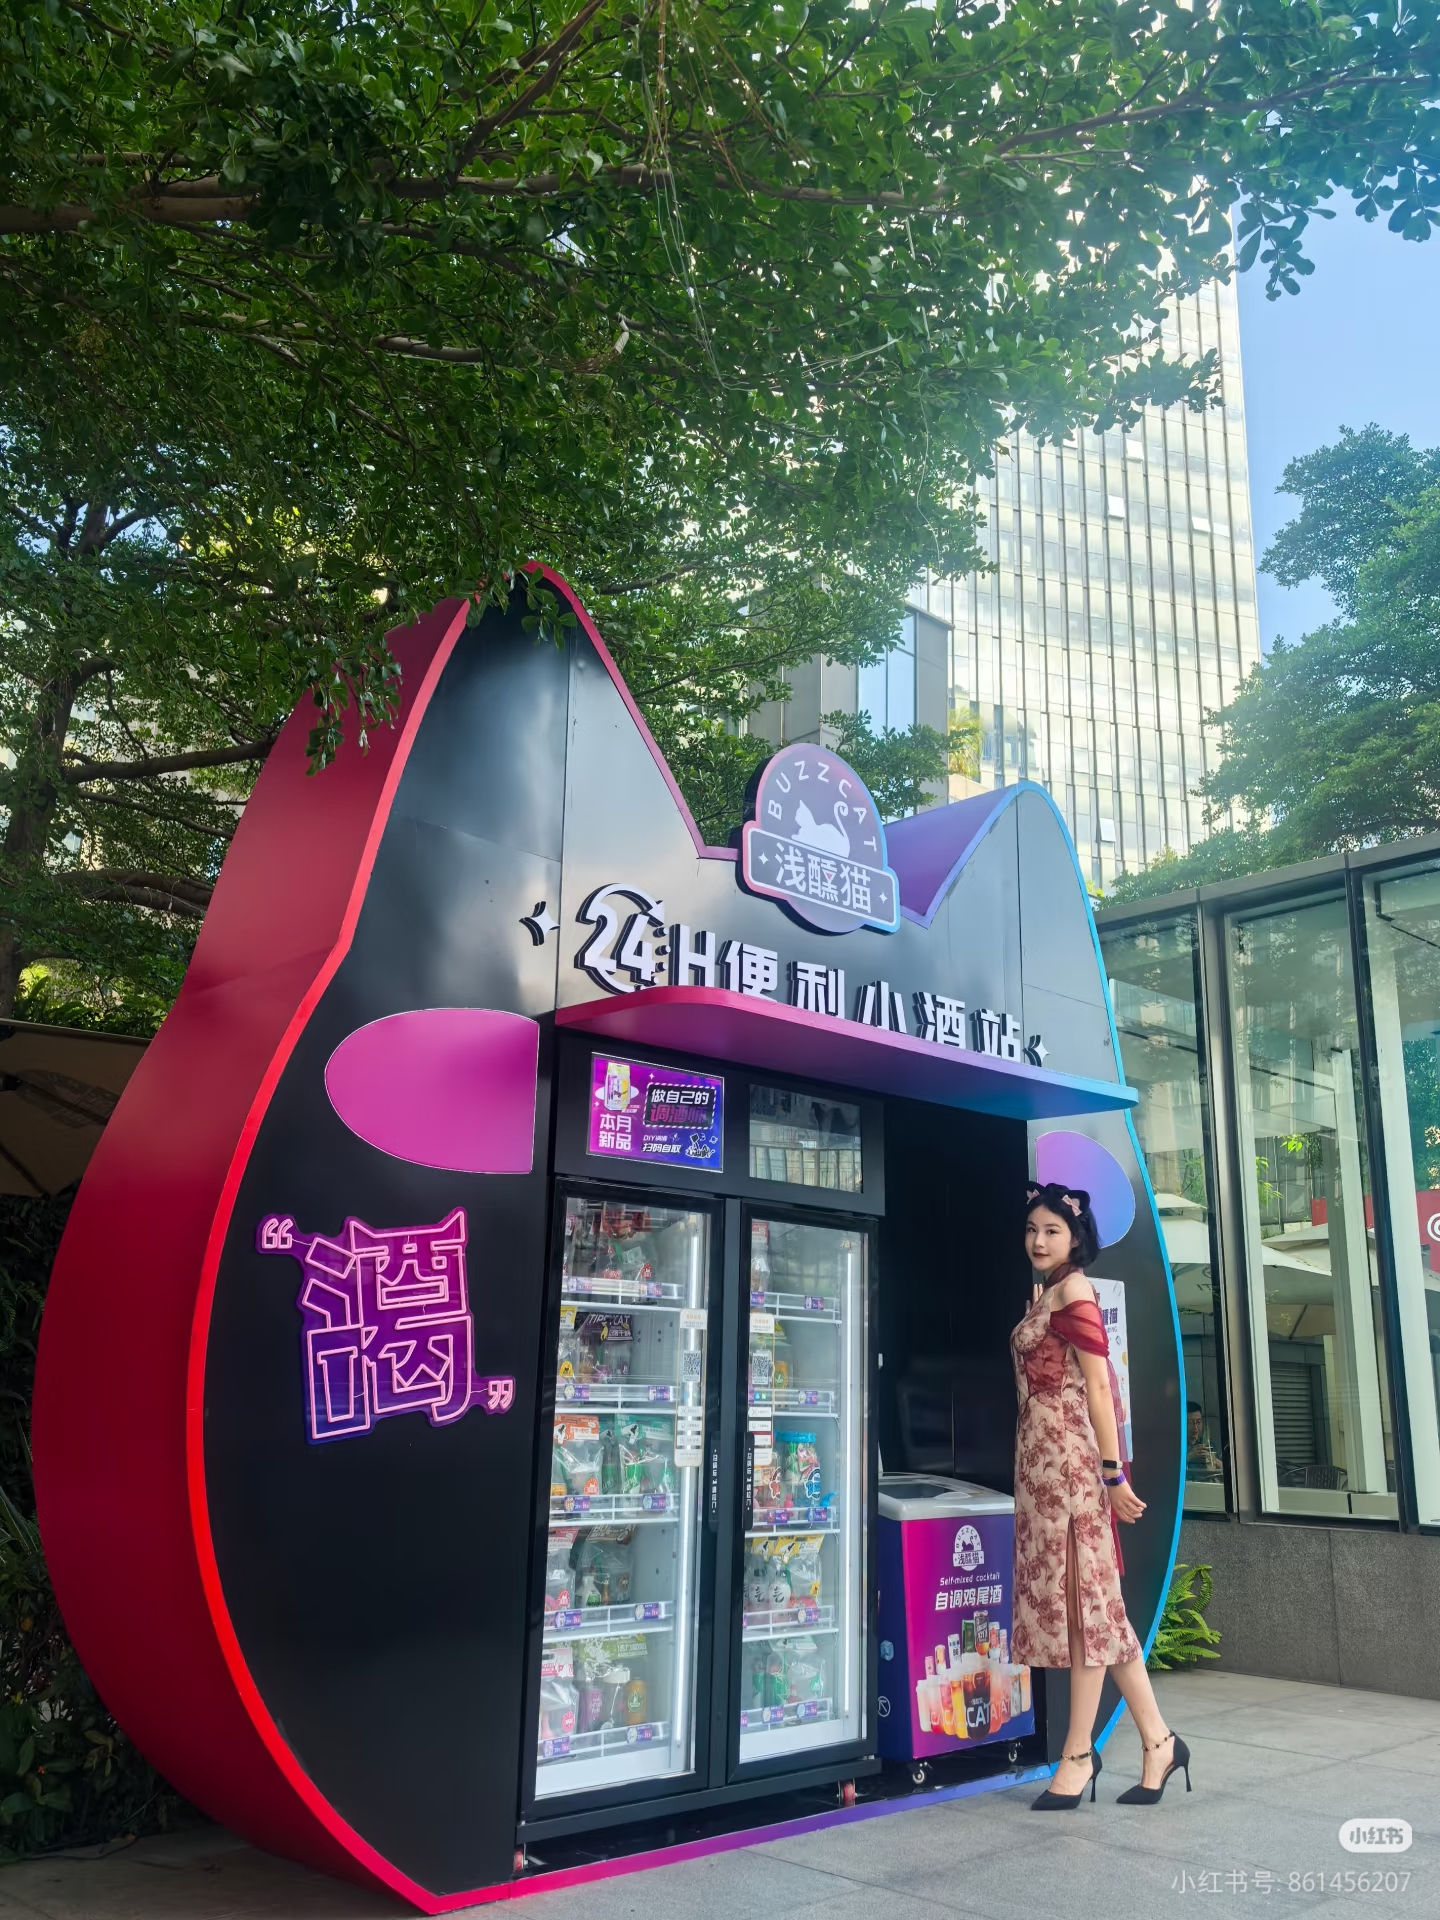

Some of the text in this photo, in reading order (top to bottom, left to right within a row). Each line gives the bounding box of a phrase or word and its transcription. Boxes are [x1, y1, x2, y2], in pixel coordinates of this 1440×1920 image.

[768, 761, 877, 852] BUZZCAT
[774, 841, 872, 914] 浅醺猫
[651, 1088, 709, 1105] 做自己的
[600, 1113, 632, 1132] 本月
[598, 1131, 632, 1151] 新品
[642, 1143, 682, 1153] 扫码自取
[956, 1527, 980, 1549] BUZZCAT
[940, 1571, 1000, 1586] Self-mixed cocktail
[935, 1584, 1003, 1611] 自调鸡尾酒
